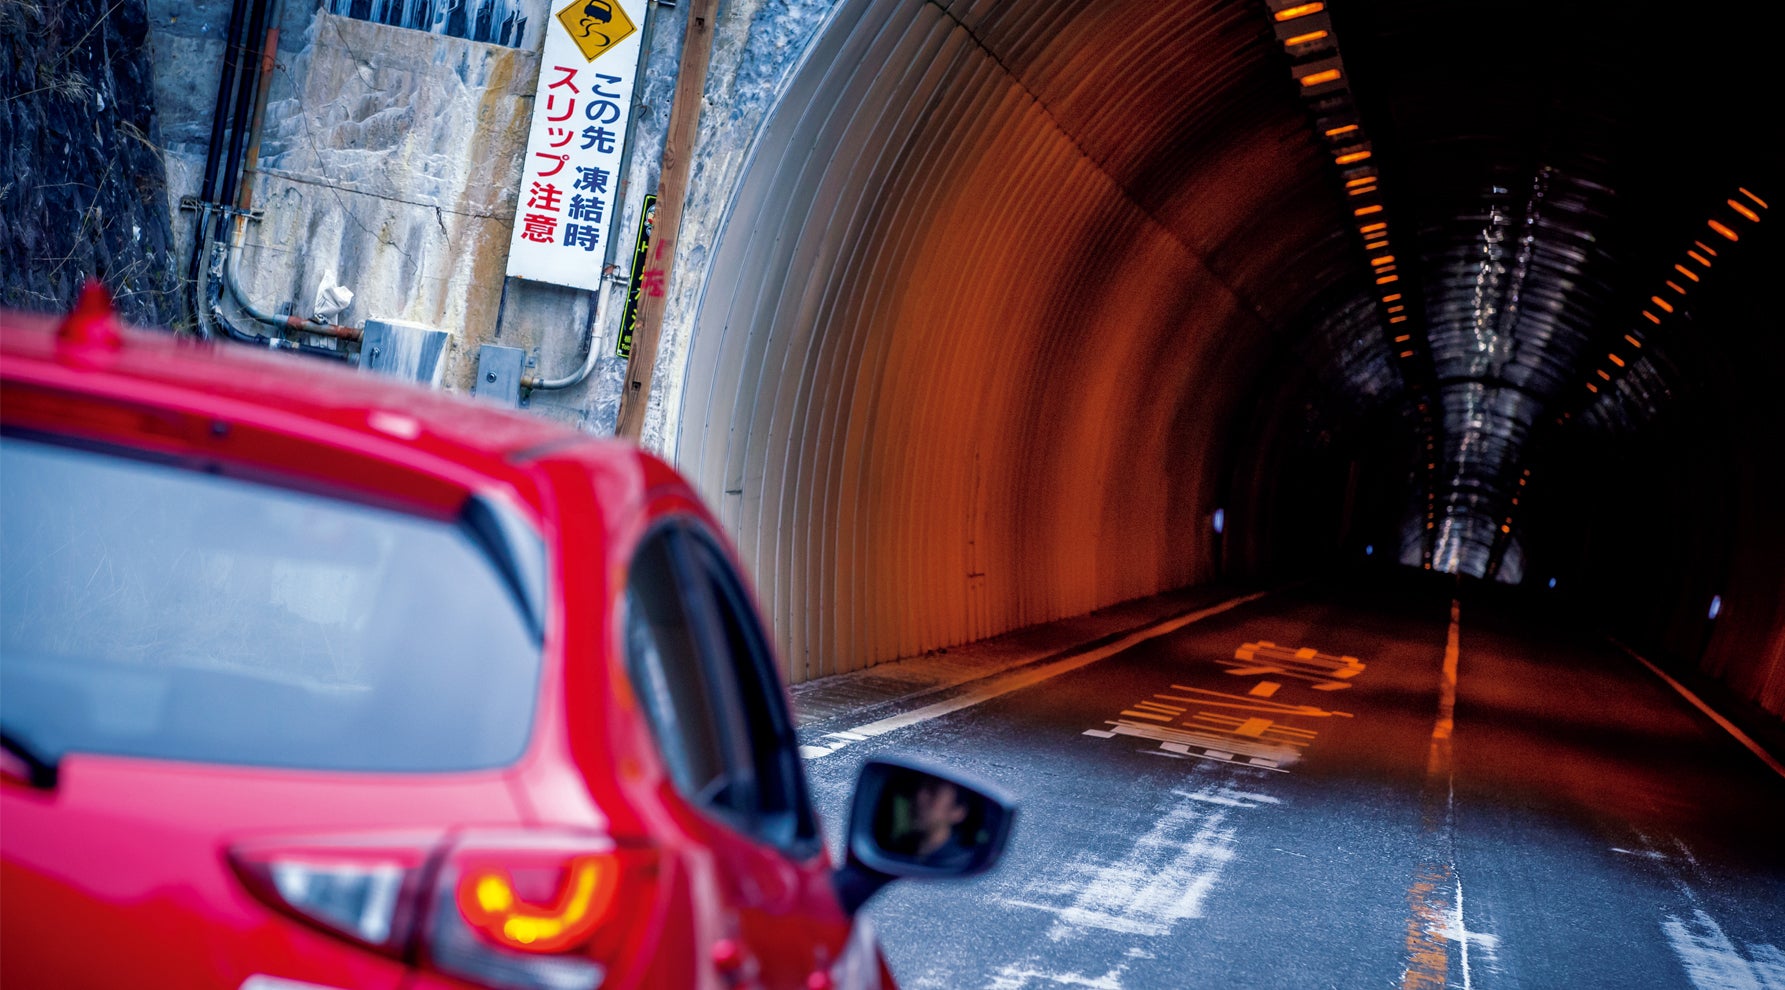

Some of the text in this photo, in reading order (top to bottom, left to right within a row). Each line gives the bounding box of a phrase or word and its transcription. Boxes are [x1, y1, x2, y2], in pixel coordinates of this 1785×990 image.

[521, 65, 581, 244] スリップ注意
[563, 72, 623, 252] この先 凍結時
